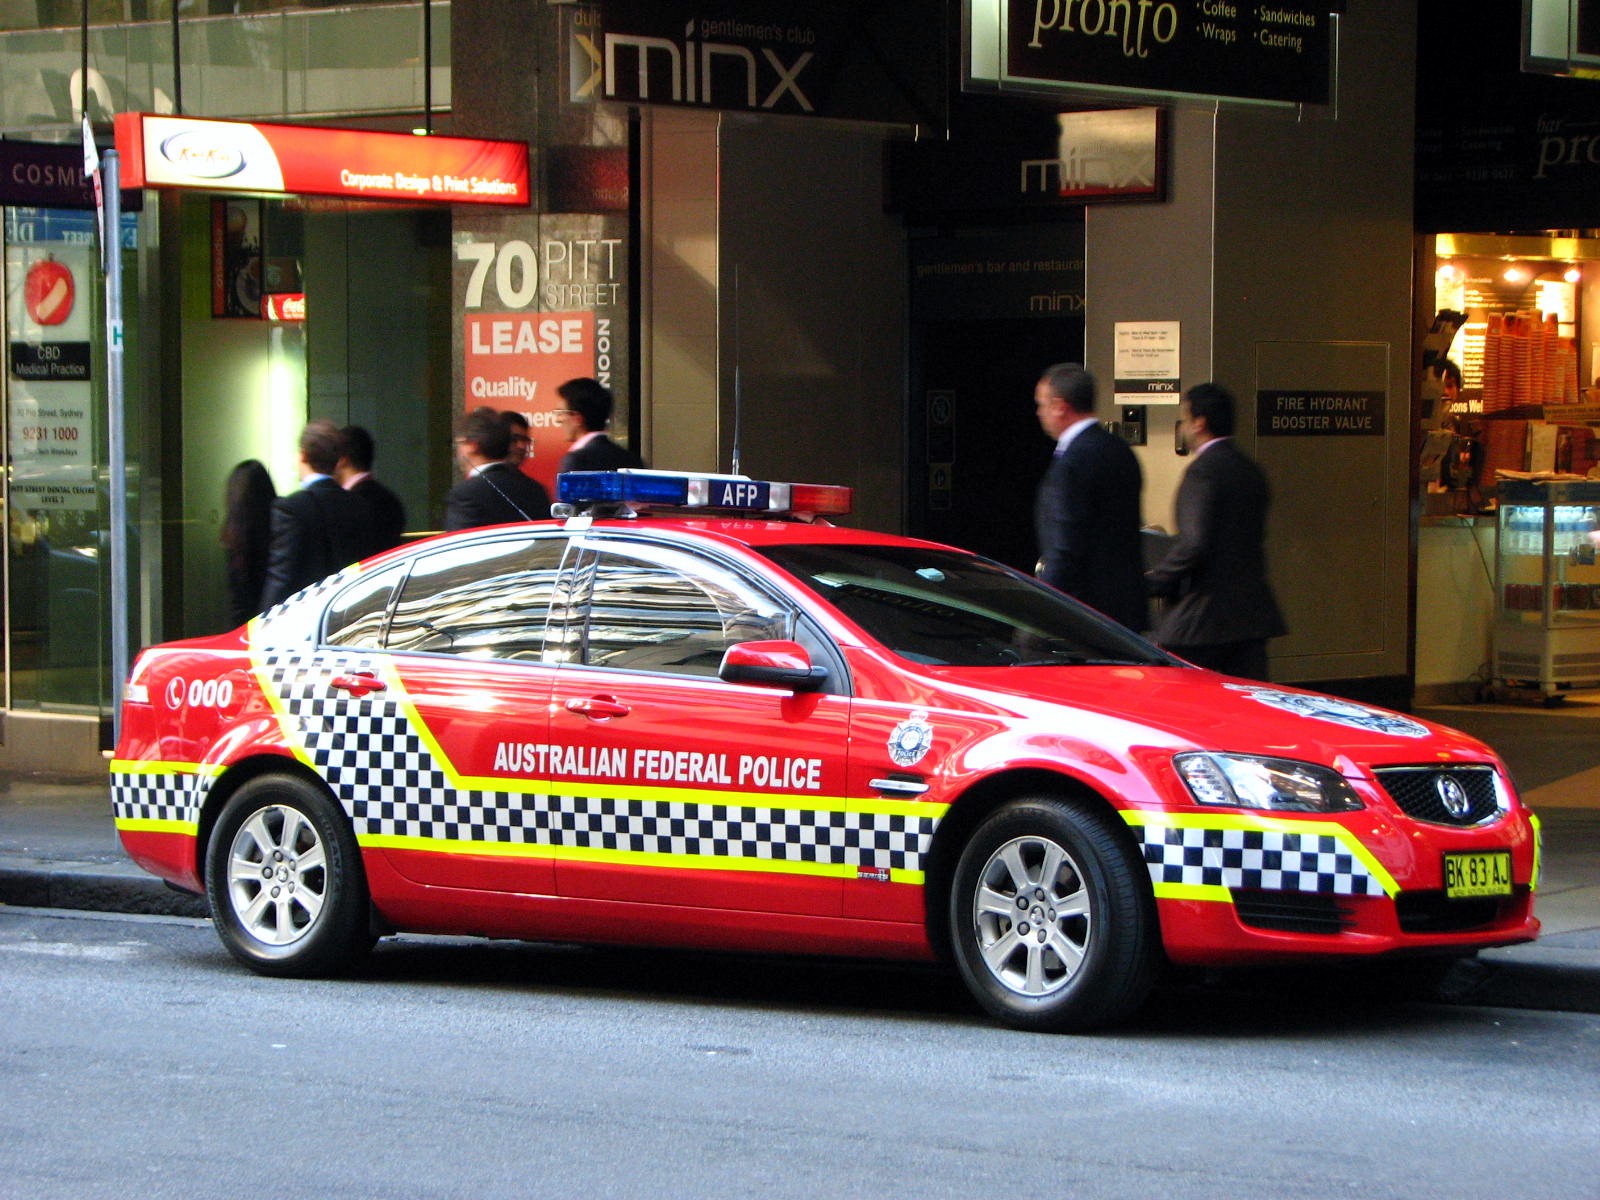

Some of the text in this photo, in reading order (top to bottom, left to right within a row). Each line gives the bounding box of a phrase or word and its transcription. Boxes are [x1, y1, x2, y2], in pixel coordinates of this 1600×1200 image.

[1202, 0, 1237, 18] Coffee
[1260, 5, 1316, 27] Sandwiches
[701, 18, 816, 45] gentlemen's club
[1028, 0, 1178, 58] pronto
[1202, 22, 1237, 45] Wraps
[1260, 28, 1303, 53] Catering
[604, 18, 815, 112] minx
[340, 169, 394, 191] Corporate
[394, 172, 430, 195] Design
[443, 175, 470, 193] Print
[470, 176, 518, 196] Solutions
[456, 239, 622, 308] 70 PITT
[987, 260, 1005, 273] bar
[1008, 259, 1030, 272] and
[544, 283, 621, 306] STREET
[471, 319, 583, 355] LEASE
[37, 345, 61, 360] CBD
[15, 362, 87, 376] Medical Practice
[471, 376, 537, 400] Quality
[1147, 381, 1175, 391] minx
[1276, 397, 1368, 410] FIRE HYDRANT
[53, 426, 79, 440] 1000
[1272, 415, 1372, 429] BOOSTER VALVE
[721, 482, 758, 507] AFP
[188, 678, 233, 709] 000
[493, 741, 822, 790] AUSTRALIAN FEDERAL POLICE
